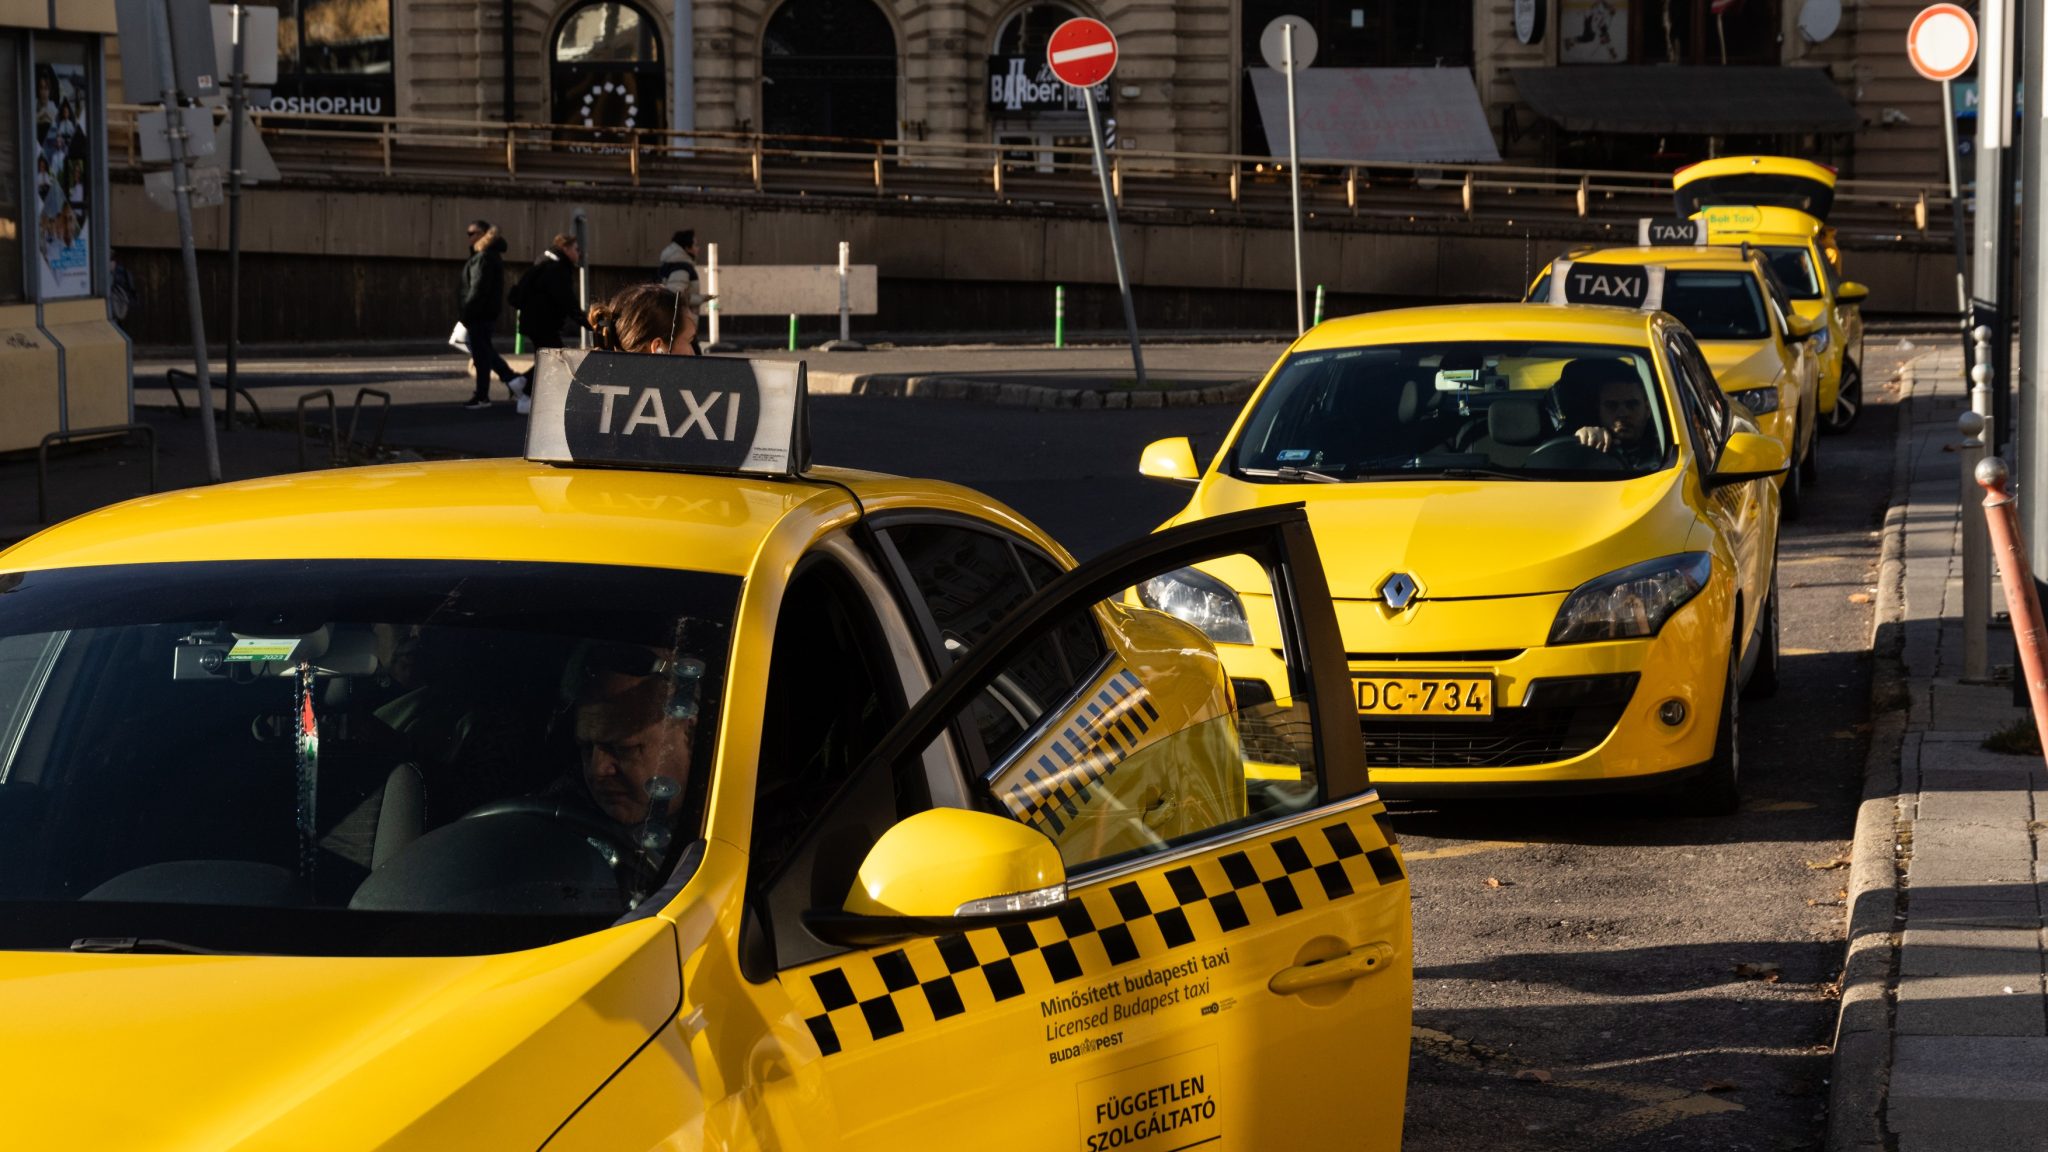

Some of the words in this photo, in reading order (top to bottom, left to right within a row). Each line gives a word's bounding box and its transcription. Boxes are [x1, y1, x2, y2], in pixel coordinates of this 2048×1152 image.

[250, 96, 382, 115] OSHOP.HU
[1653, 225, 1695, 239] TAXI
[1710, 215, 1729, 224] Bolt
[1733, 214, 1754, 224] Taxi
[1574, 275, 1641, 298] TAXI
[594, 382, 742, 443] TAXI
[1356, 680, 1484, 712] DC-734
[1040, 979, 1122, 1018] Minősített
[1123, 956, 1199, 993] budapesti
[1201, 947, 1231, 970] taxi
[1046, 1006, 1109, 1042] Licensed
[1113, 988, 1181, 1021] Budapest
[1184, 976, 1211, 1000] taxi
[1096, 1074, 1205, 1125] FÜGGETLEN
[1086, 1094, 1216, 1152] SZOLGÁLTATÓ
